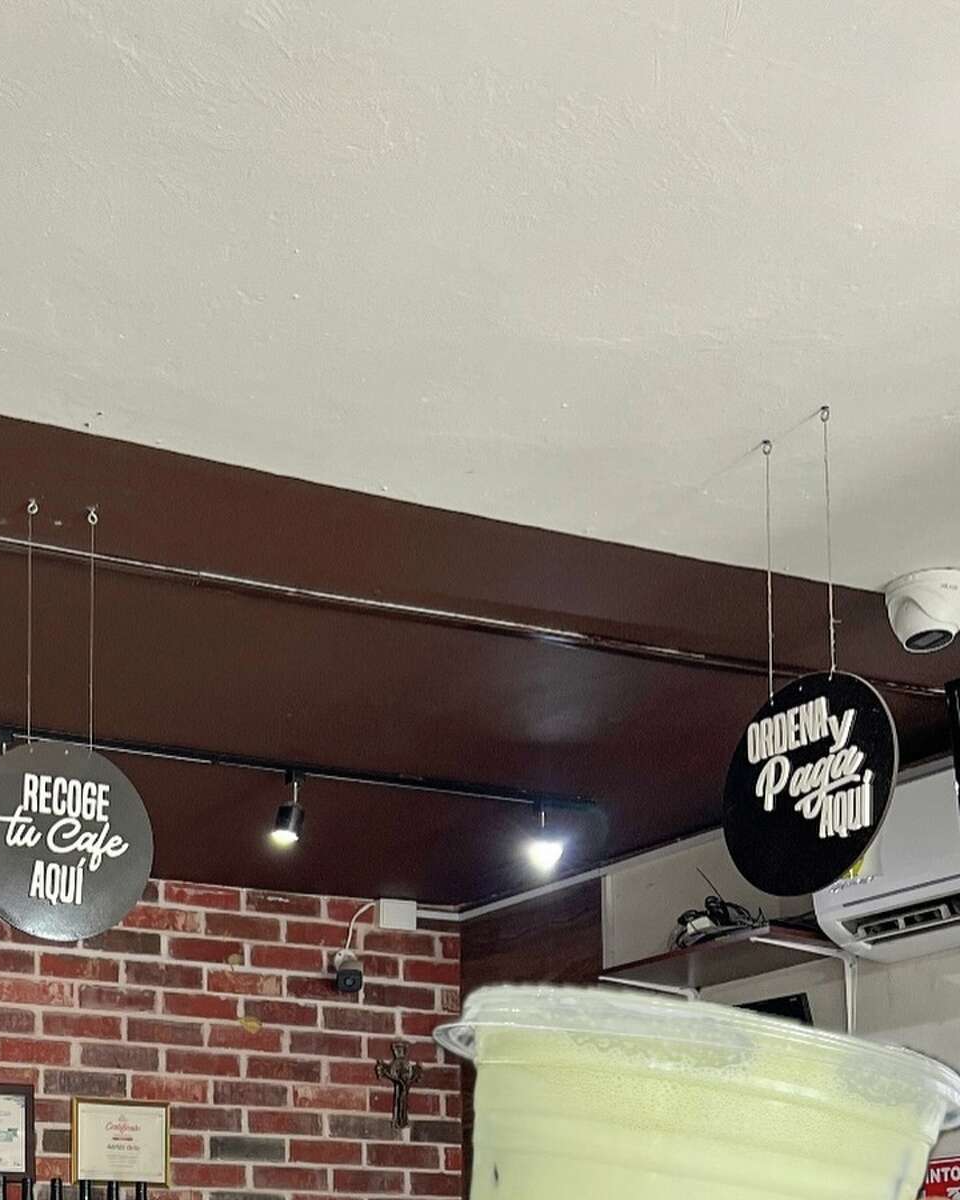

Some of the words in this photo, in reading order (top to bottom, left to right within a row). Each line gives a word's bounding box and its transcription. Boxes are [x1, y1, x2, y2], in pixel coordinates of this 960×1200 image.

[747, 696, 829, 764] ORDENA
[829, 708, 855, 753] y
[22, 773, 110, 822] RECOGE
[755, 745, 864, 819] Paga
[818, 769, 874, 839] AQUÍ
[47, 817, 129, 872] Cafe
[30, 858, 85, 905] AQUÍ
[926, 1165, 960, 1184] INTO
